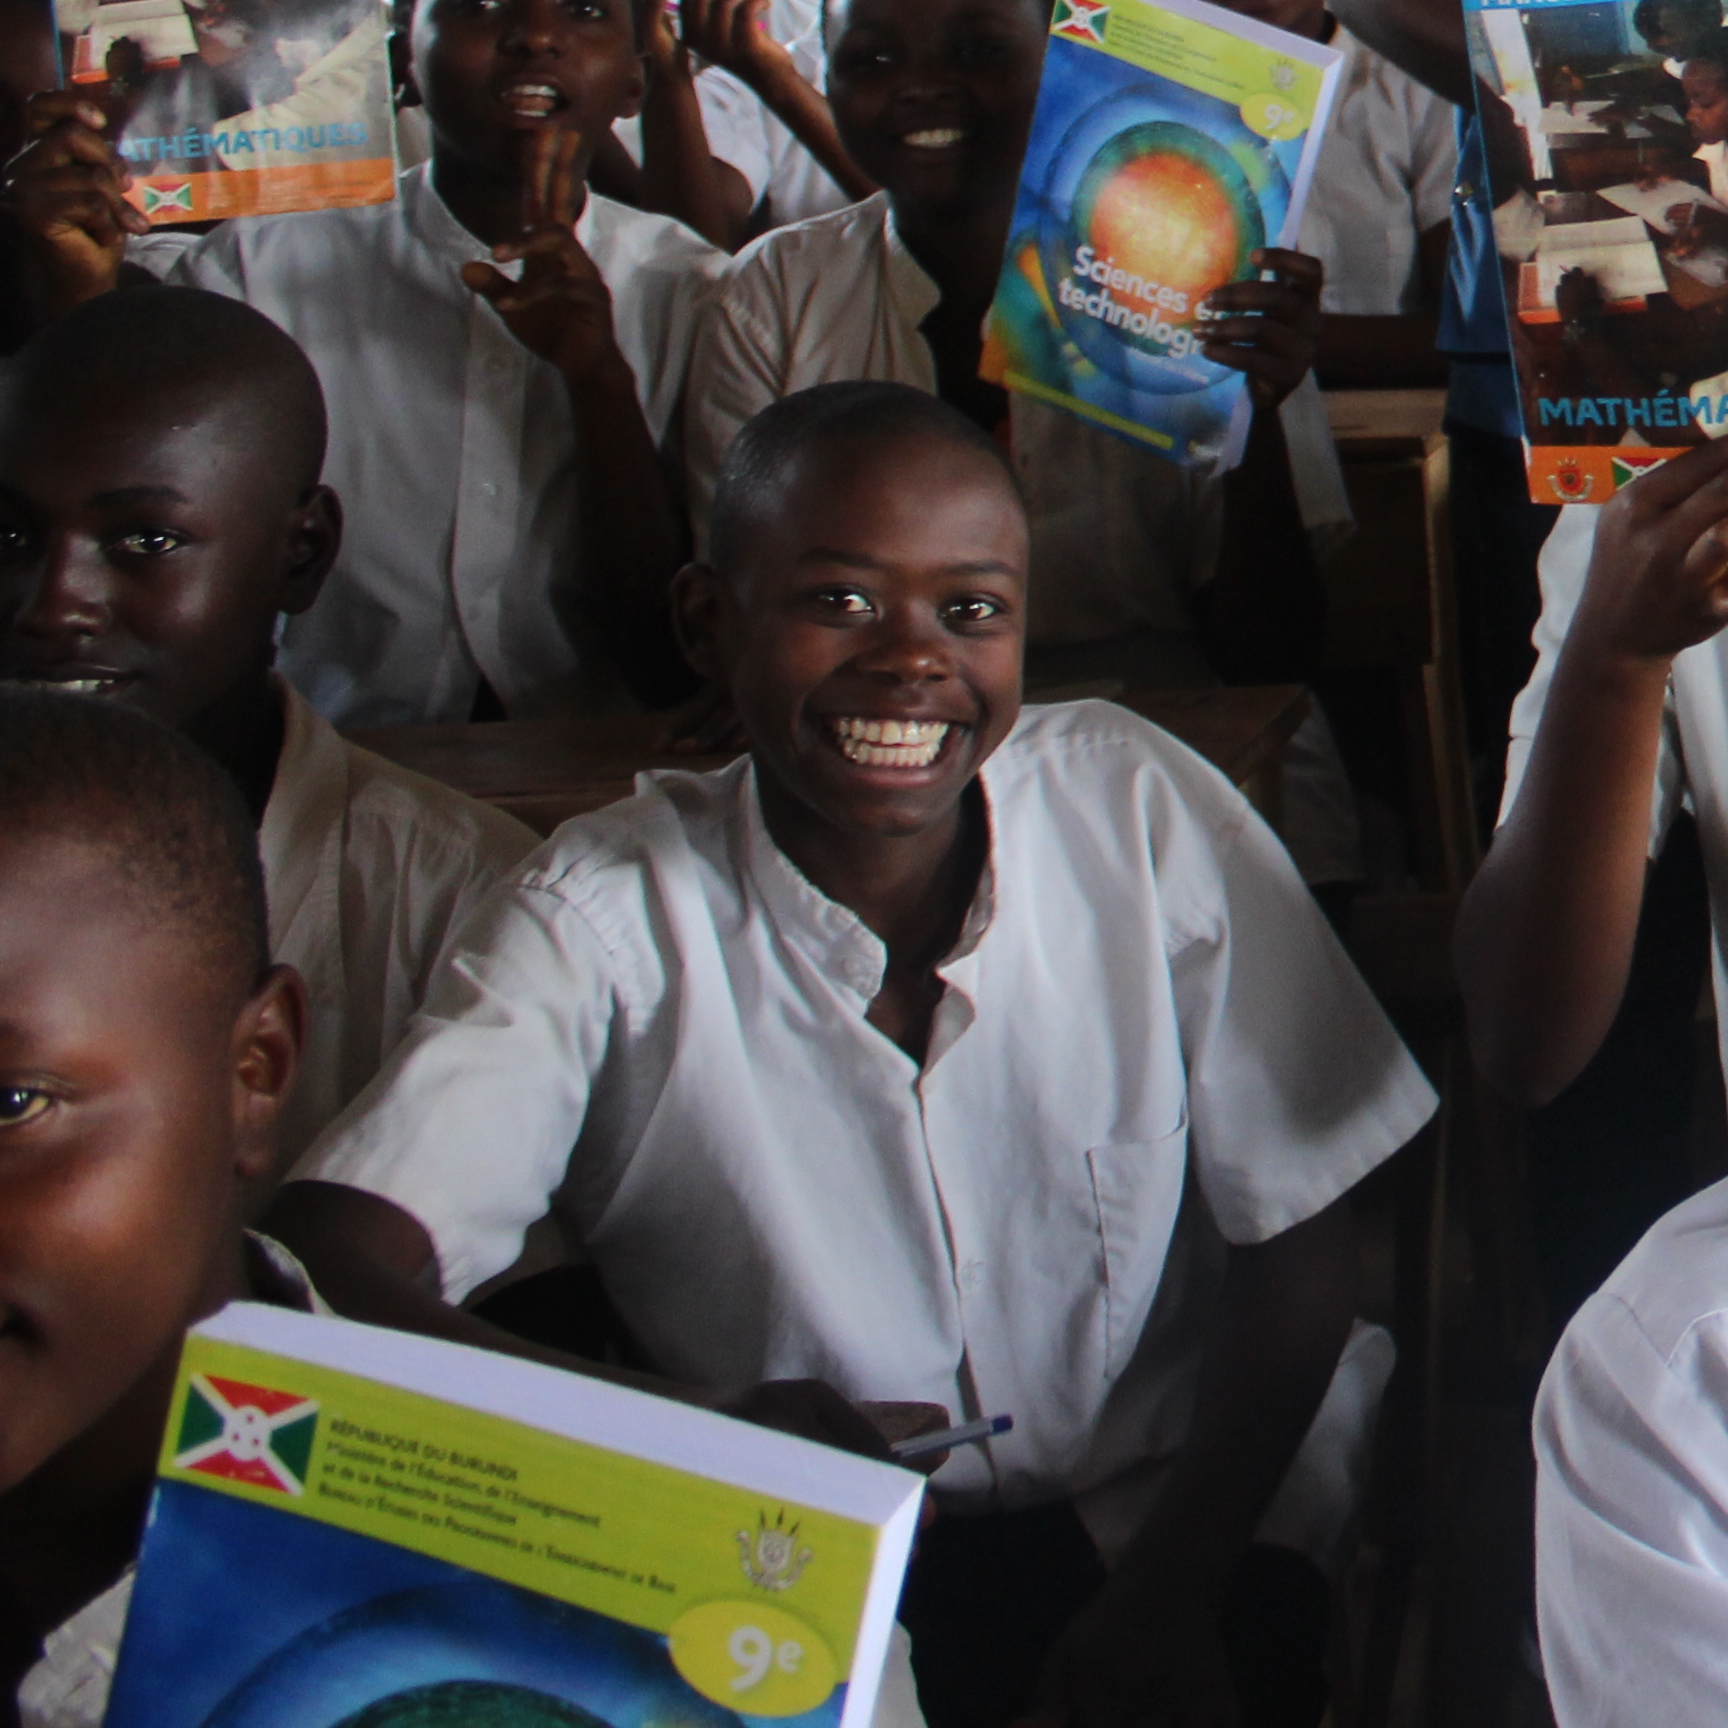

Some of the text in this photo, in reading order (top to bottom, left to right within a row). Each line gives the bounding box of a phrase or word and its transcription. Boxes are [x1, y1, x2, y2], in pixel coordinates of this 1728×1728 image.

[110, 122, 368, 162] ATHÉMATIQUES
[1073, 245, 1189, 314] Sciences
[1058, 276, 1206, 359] technologi
[728, 1625, 805, 1692] 9e
